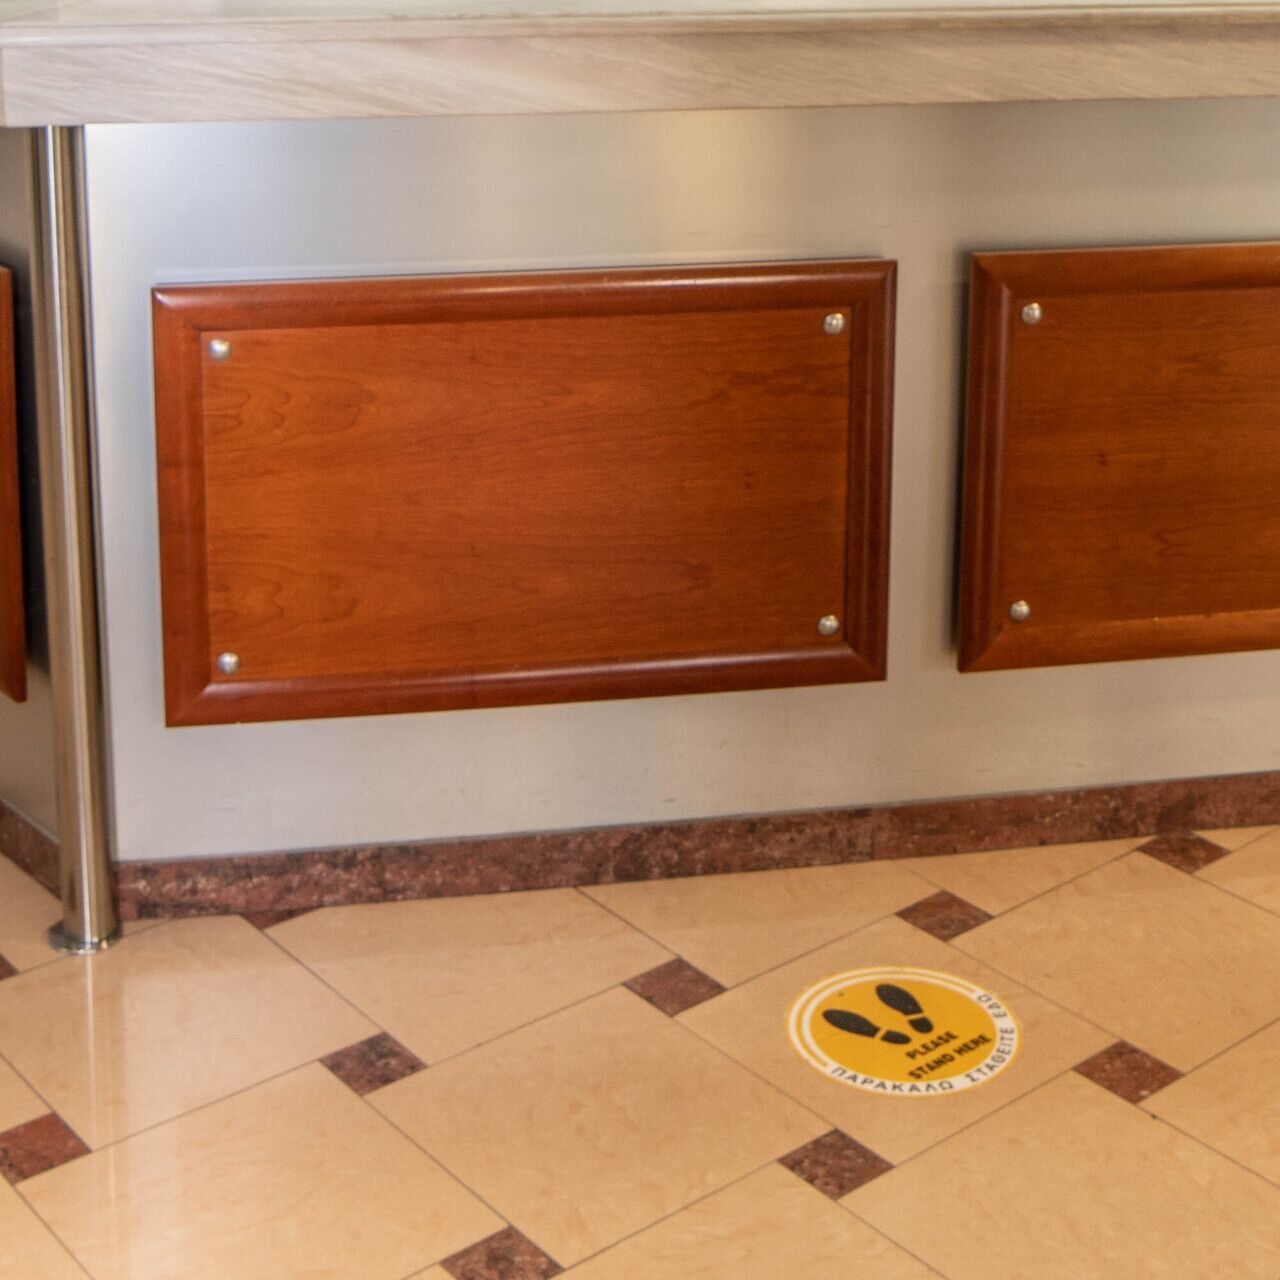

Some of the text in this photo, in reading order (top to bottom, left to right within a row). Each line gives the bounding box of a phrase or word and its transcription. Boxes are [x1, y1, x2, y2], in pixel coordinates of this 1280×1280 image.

[905, 1030, 960, 1060] PLEASE
[907, 1033, 993, 1080] STAND HERE
[831, 1066, 955, 1093] ΠΑΡΑΚΑΛΩ
